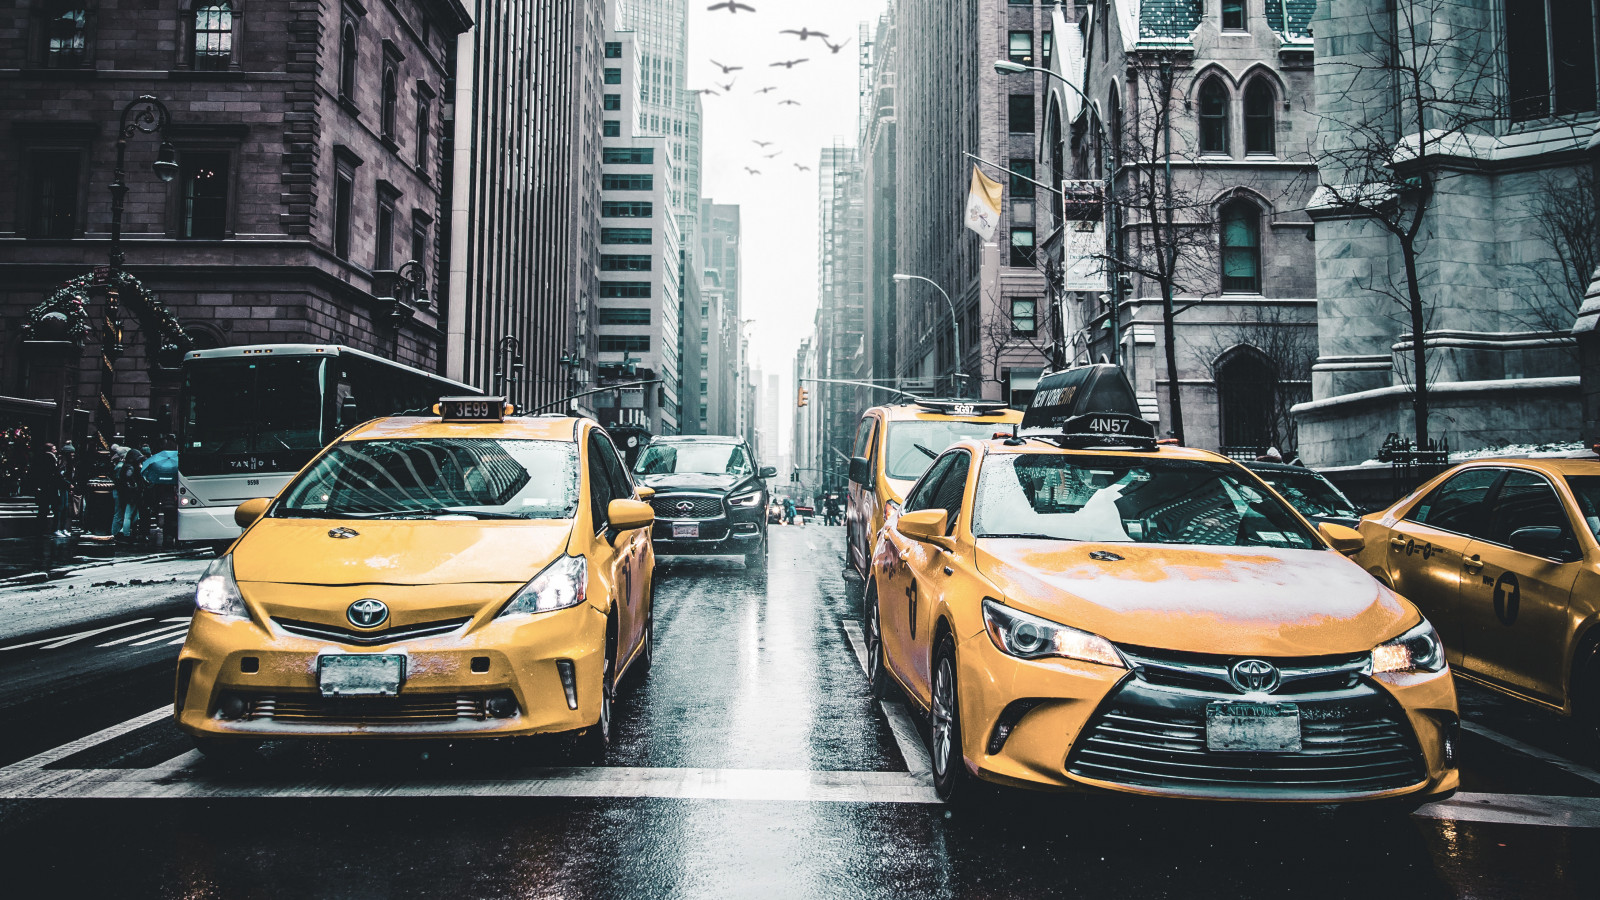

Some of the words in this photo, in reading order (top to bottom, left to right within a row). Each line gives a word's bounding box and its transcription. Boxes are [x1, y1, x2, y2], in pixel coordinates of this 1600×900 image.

[1031, 390, 1049, 408] NEW
[456, 402, 489, 417] 3E99
[954, 405, 974, 414] 5G97
[1089, 418, 1130, 433] 4N57
[1229, 706, 1250, 716] NEW
[1251, 706, 1276, 716] YORK
